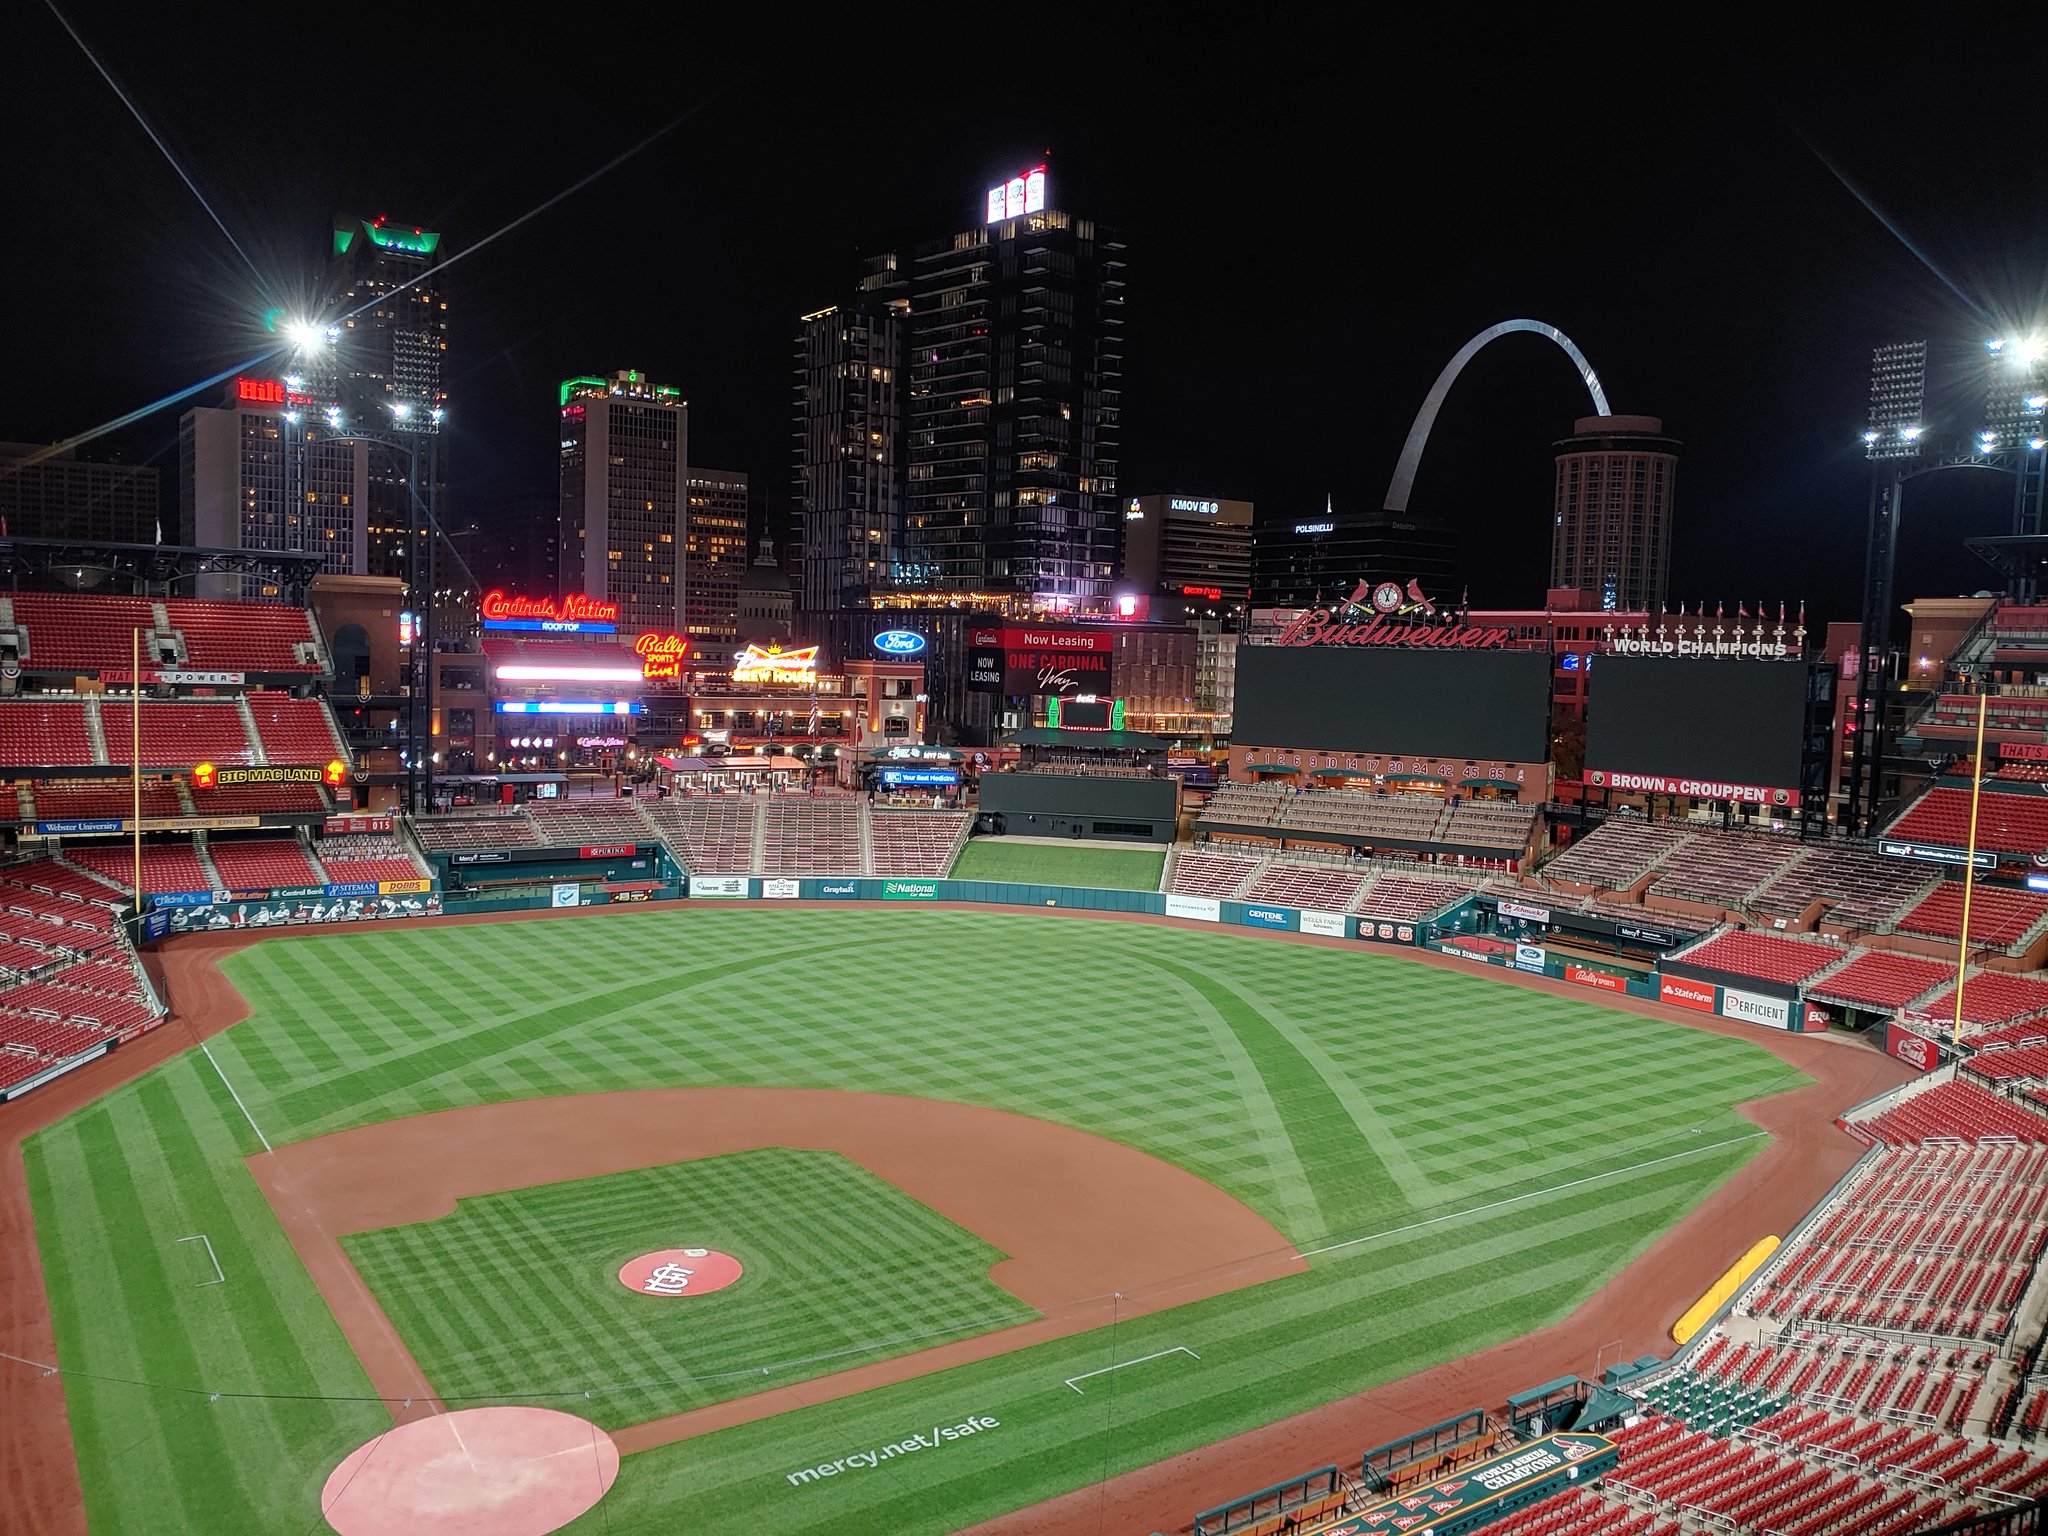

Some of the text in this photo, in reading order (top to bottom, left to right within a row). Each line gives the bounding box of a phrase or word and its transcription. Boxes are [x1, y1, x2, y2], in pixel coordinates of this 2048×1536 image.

[1171, 499, 1198, 512] KMOV
[1295, 523, 1334, 534] POLSINELLI
[483, 592, 617, 621] Cardinals Nation
[542, 622, 580, 631] ROOFTOP
[1272, 610, 1510, 647] Budweiser
[885, 633, 915, 649] Ford
[975, 631, 997, 645] Cardinals
[1024, 633, 1094, 649] Now Leasing
[635, 633, 687, 659] Bally
[1613, 639, 1787, 656] WORLD CHAMPIONS
[647, 654, 674, 662] SPORTS
[977, 657, 994, 669] NOW
[1008, 653, 1107, 671] ONE CARDINAL
[643, 662, 680, 678] Live!
[772, 671, 816, 682] HOUSE
[970, 671, 1000, 683] LEASING
[175, 674, 227, 682] POWER
[1037, 663, 1079, 692] Way
[2002, 745, 2043, 758] THAT'S
[1277, 754, 1285, 765] 2
[1293, 755, 1301, 766] 6
[1309, 756, 1317, 767] 9
[1326, 757, 1337, 768] 10
[1346, 758, 1358, 770] 14
[1367, 760, 1379, 771] 17
[1388, 761, 1404, 773] 20
[1412, 763, 1428, 775] 24
[1438, 764, 1453, 776] 42
[1463, 766, 1479, 778] 45
[1488, 768, 1505, 780] 85
[218, 769, 322, 783] BIG MAC LAND
[930, 774, 955, 782] Medicine
[1611, 774, 1765, 801] BROWN & CROUPPEN
[46, 823, 117, 832] Webster University
[372, 821, 390, 830] 015
[1886, 846, 1906, 855] Mercy
[281, 888, 324, 897] Central Bank
[897, 884, 935, 893] National
[1249, 910, 1284, 920] CENTENE
[1622, 928, 1636, 937] Mercy
[1442, 946, 1488, 962] BUSCH STADIUM
[1523, 949, 1540, 957] Ford
[1576, 971, 1615, 987] Bally SPORTS
[1726, 995, 1785, 1020] PERFICIENT
[786, 1415, 1000, 1486] mercy.net/safe
[1471, 1448, 1548, 1483] WORLD SERIES
[1484, 1454, 1561, 1490] CHAMPIONS
